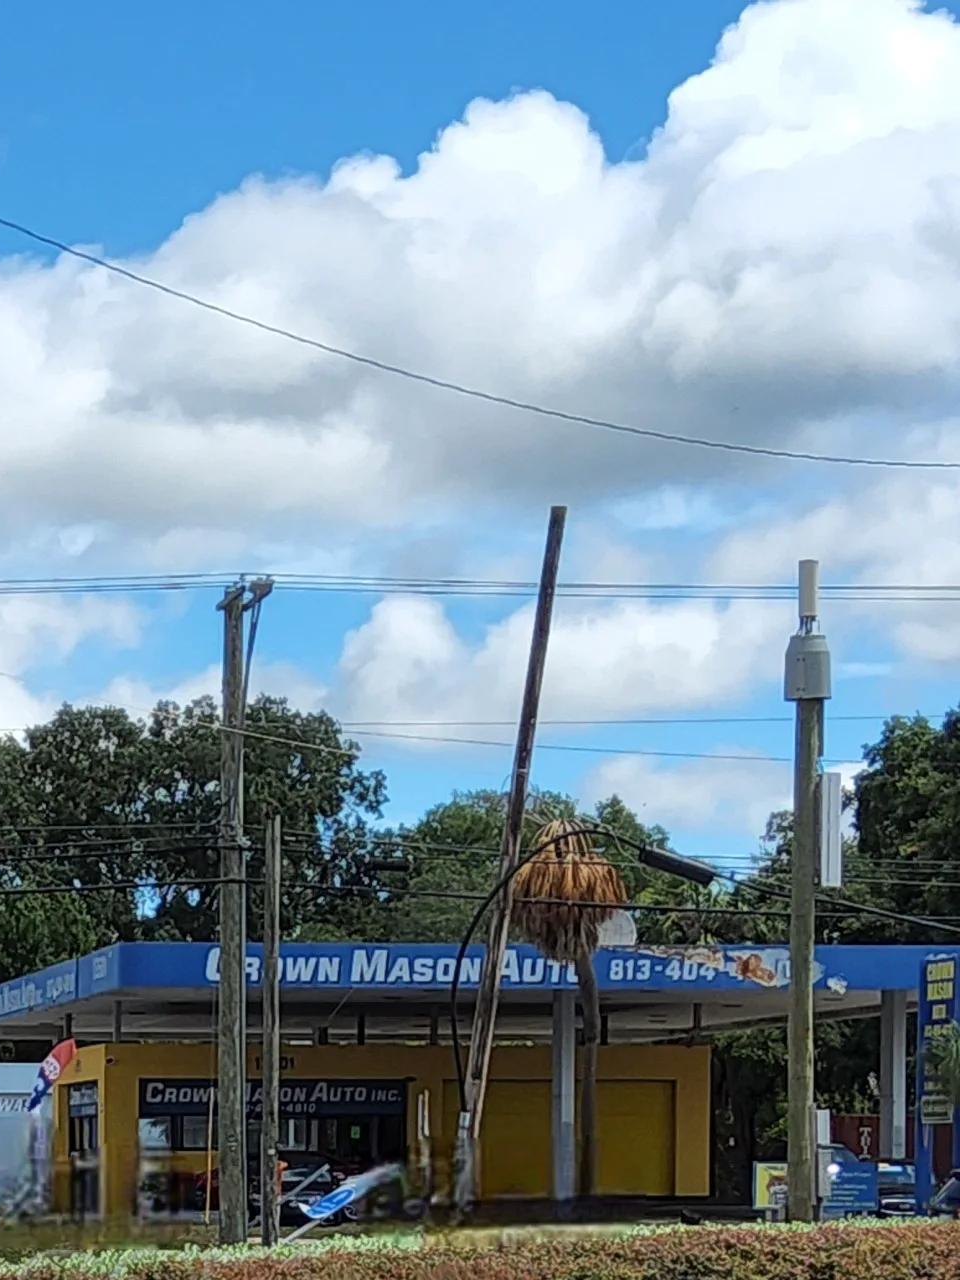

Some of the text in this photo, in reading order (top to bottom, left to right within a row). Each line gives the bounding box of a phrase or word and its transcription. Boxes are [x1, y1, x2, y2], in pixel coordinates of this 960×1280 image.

[351, 948, 481, 983] MASON
[145, 1082, 218, 1103] CROW
[312, 1081, 368, 1103] AUTO
[371, 1088, 403, 1102] INC.
